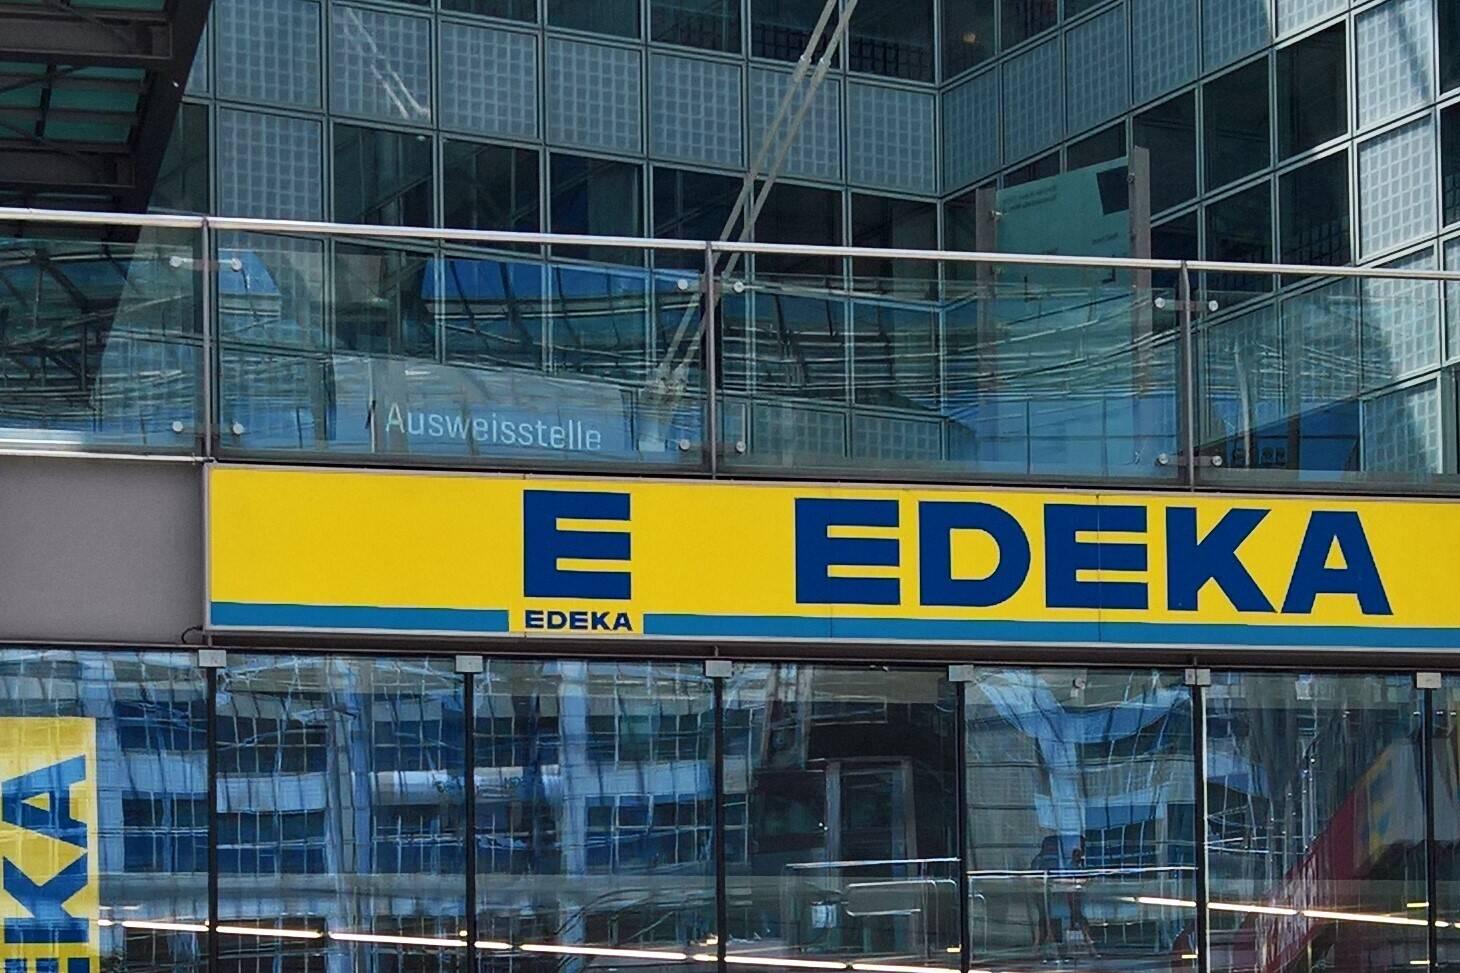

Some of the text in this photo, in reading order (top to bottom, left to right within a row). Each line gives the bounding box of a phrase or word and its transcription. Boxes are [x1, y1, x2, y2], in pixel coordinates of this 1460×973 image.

[385, 402, 602, 450] Ausweisstelle
[523, 489, 631, 600] E
[795, 497, 1393, 616] EDEKA
[525, 609, 633, 631] EDEKA
